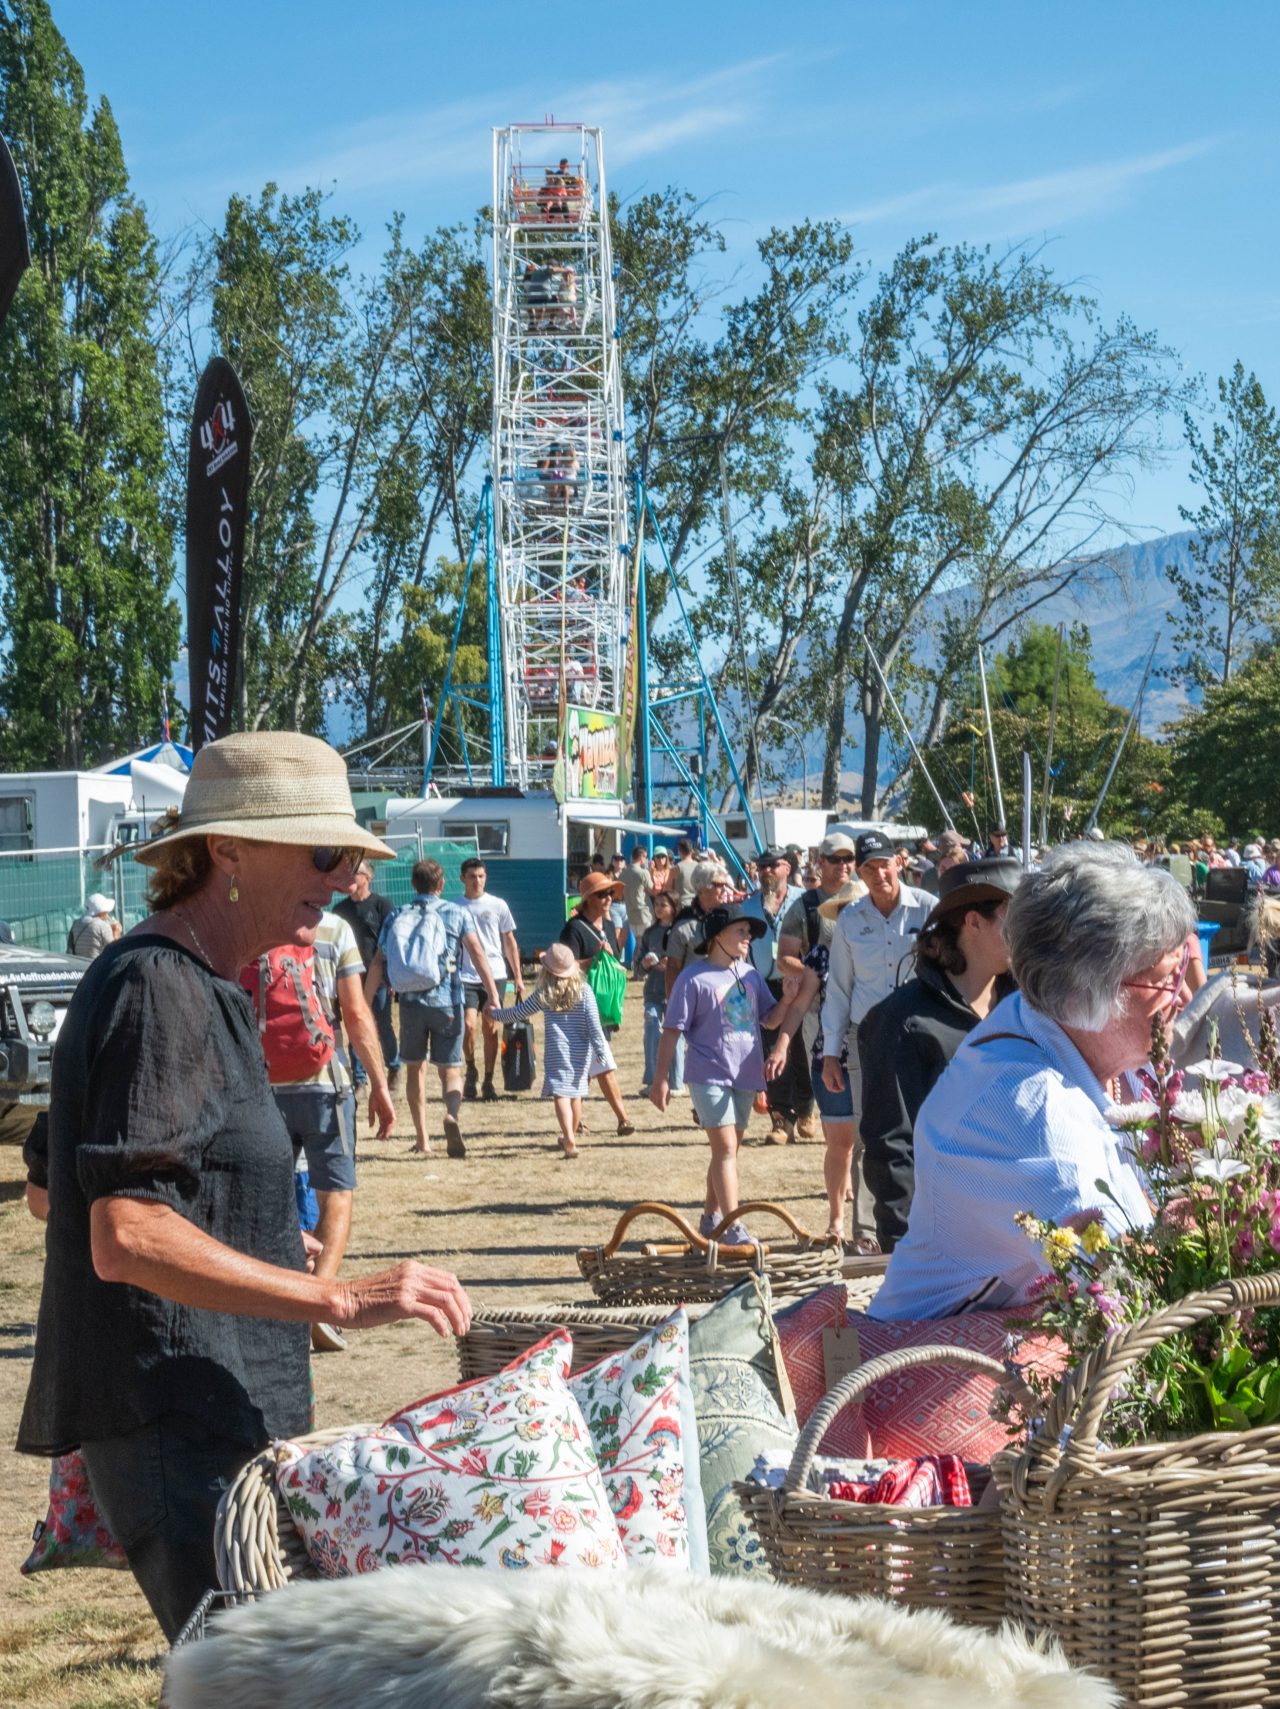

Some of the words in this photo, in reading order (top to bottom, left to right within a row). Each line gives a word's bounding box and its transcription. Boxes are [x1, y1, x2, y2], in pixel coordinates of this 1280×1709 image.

[214, 487, 233, 631] ALLOY
[219, 660, 229, 718] EXPLORE
[225, 599, 231, 617] NO
